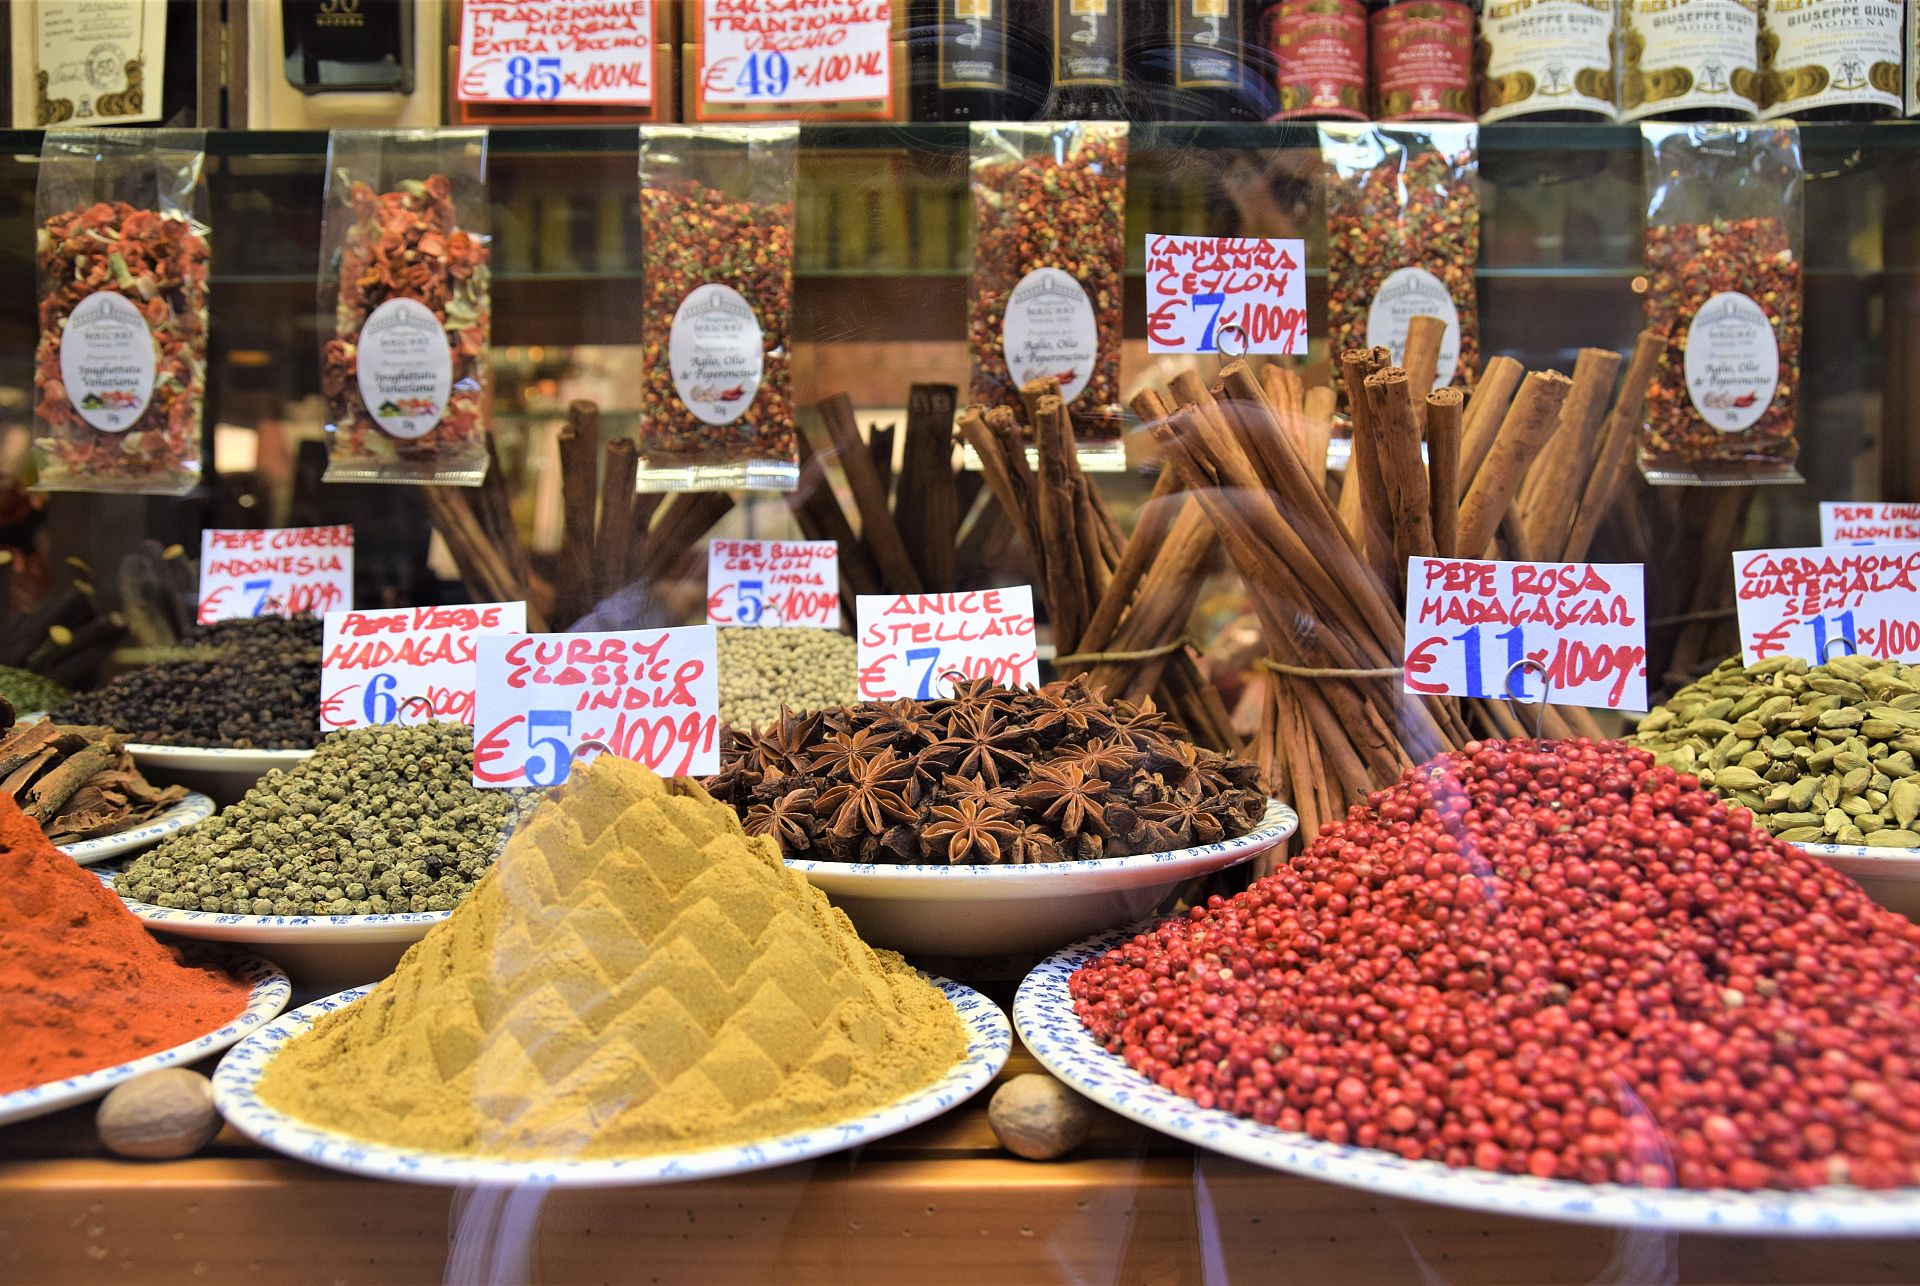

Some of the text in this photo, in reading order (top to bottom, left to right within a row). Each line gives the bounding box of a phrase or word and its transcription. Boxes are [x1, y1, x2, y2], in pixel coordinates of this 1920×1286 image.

[468, 1, 646, 22] TRADIZIONALE
[709, 5, 891, 32] TRADIZIONALE
[1653, 11, 1720, 28] GIUSEPPE
[1788, 6, 1897, 27] GIUSEPPE GIUSTI
[1811, 18, 1884, 30] MODENA
[475, 17, 637, 37] DI MODENA
[745, 29, 847, 51] VECCHIO
[472, 39, 547, 55] EXTRA
[460, 58, 502, 96] €
[505, 56, 561, 101] 85
[705, 57, 738, 93] €
[736, 52, 790, 96] 49
[1151, 235, 1276, 255] CANNELLA
[1146, 250, 1297, 272] IN CANNA
[1156, 271, 1288, 297] CEYLON
[1147, 299, 1187, 346] €
[1192, 293, 1225, 351] 7
[1834, 506, 1873, 521] PEPE
[211, 529, 264, 551] PEPE
[714, 541, 837, 559] PEPE BIANCO
[208, 554, 343, 577] INDONESIA
[724, 558, 811, 573] CEYLON
[770, 573, 823, 585] INDIA
[1424, 560, 1611, 598] PEPE ROSA
[1739, 569, 1917, 599] GUATEMALA
[197, 585, 233, 625] €
[244, 579, 272, 617] 7
[708, 584, 734, 622] €
[737, 581, 763, 624] 5
[883, 590, 1003, 615] ANICE
[1419, 595, 1635, 630] MADAGASCAR
[1782, 593, 1863, 616] SEMI
[340, 606, 502, 636] PEPE VERDE
[863, 614, 1036, 647] STELLATO
[505, 633, 669, 666] CURRY
[1750, 619, 1800, 660] €
[1804, 610, 1857, 666] 11
[507, 659, 704, 688] CLASSICO
[857, 654, 897, 698] €
[906, 647, 940, 700] 7
[1405, 636, 1449, 693] €
[1453, 625, 1534, 699] 11
[320, 684, 360, 727] €
[363, 673, 397, 727] 6
[576, 682, 697, 711] INDIA
[473, 714, 526, 783] €
[525, 710, 572, 786] 5
